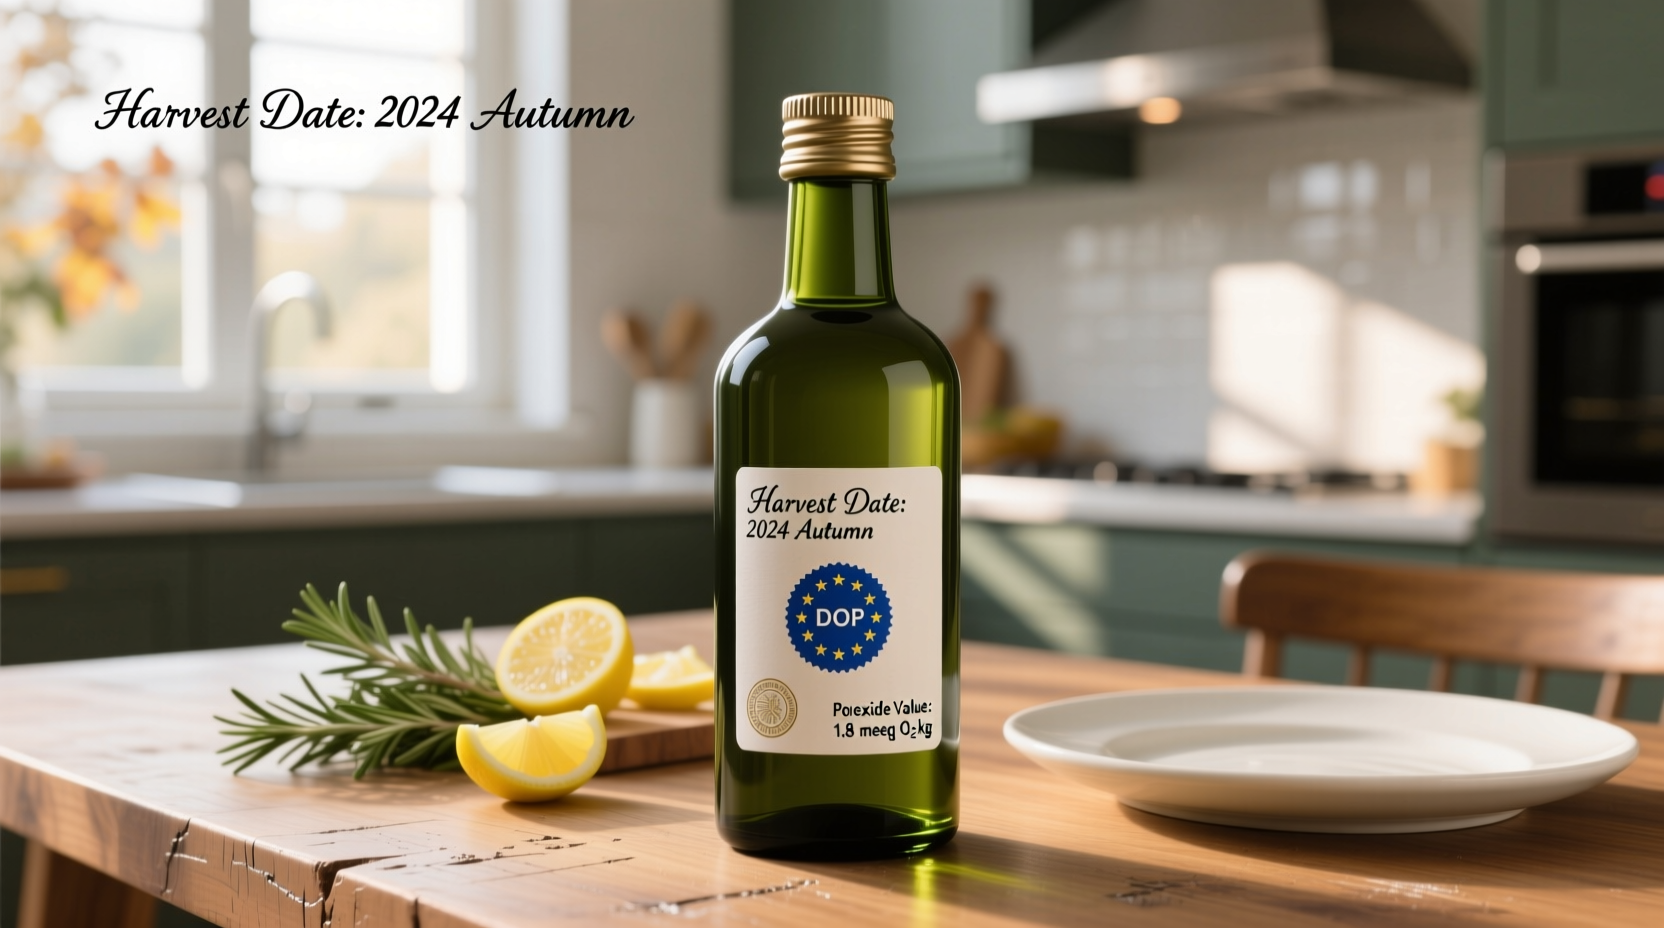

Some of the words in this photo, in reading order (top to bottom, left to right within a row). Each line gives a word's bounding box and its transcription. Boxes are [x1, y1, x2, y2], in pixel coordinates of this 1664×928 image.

[747, 484, 838, 514] Harvest
[843, 487, 906, 515] Date:
[746, 519, 790, 540] 2024
[794, 518, 874, 540] Autumn
[816, 608, 865, 628] DOP
[893, 699, 932, 715] Value:
[833, 722, 855, 738] 1.8
